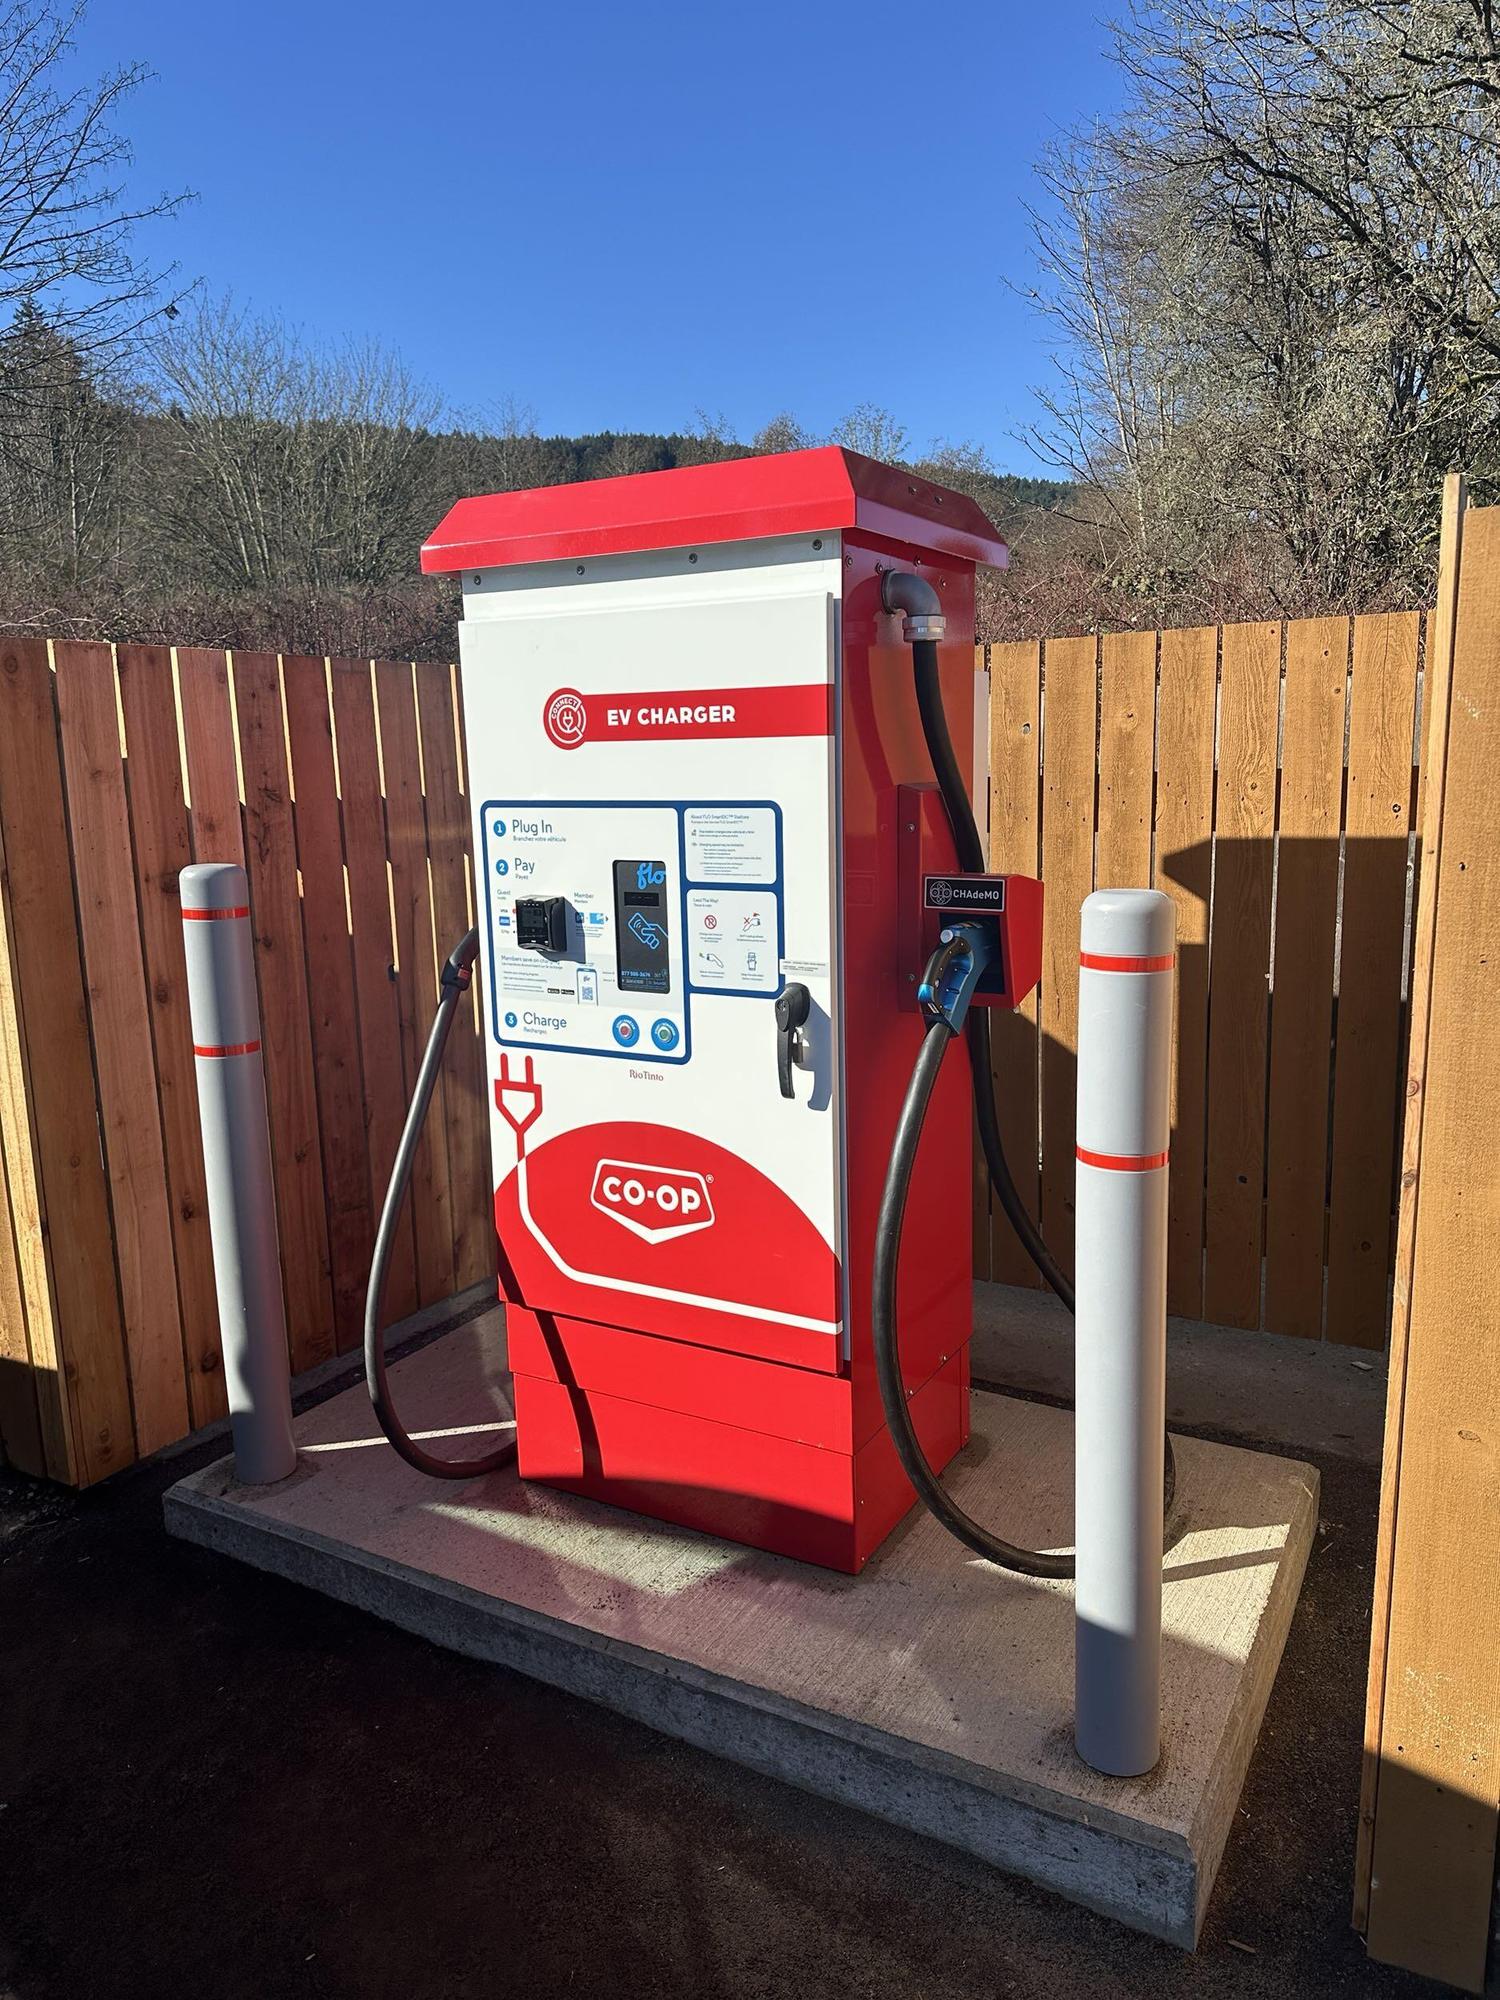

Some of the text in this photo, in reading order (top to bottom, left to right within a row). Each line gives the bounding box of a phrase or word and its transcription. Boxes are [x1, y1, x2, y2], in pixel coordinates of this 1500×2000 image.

[551, 698, 579, 719] CONNECT
[607, 705, 736, 726] EV CHARGER
[512, 819, 539, 836] Plug
[541, 819, 553, 833] In
[514, 858, 535, 874] Pay
[637, 862, 666, 889] flo
[952, 889, 1000, 900] CHAdeMO
[523, 1012, 567, 1030] Charge
[603, 1176, 701, 1214] CO-OP
